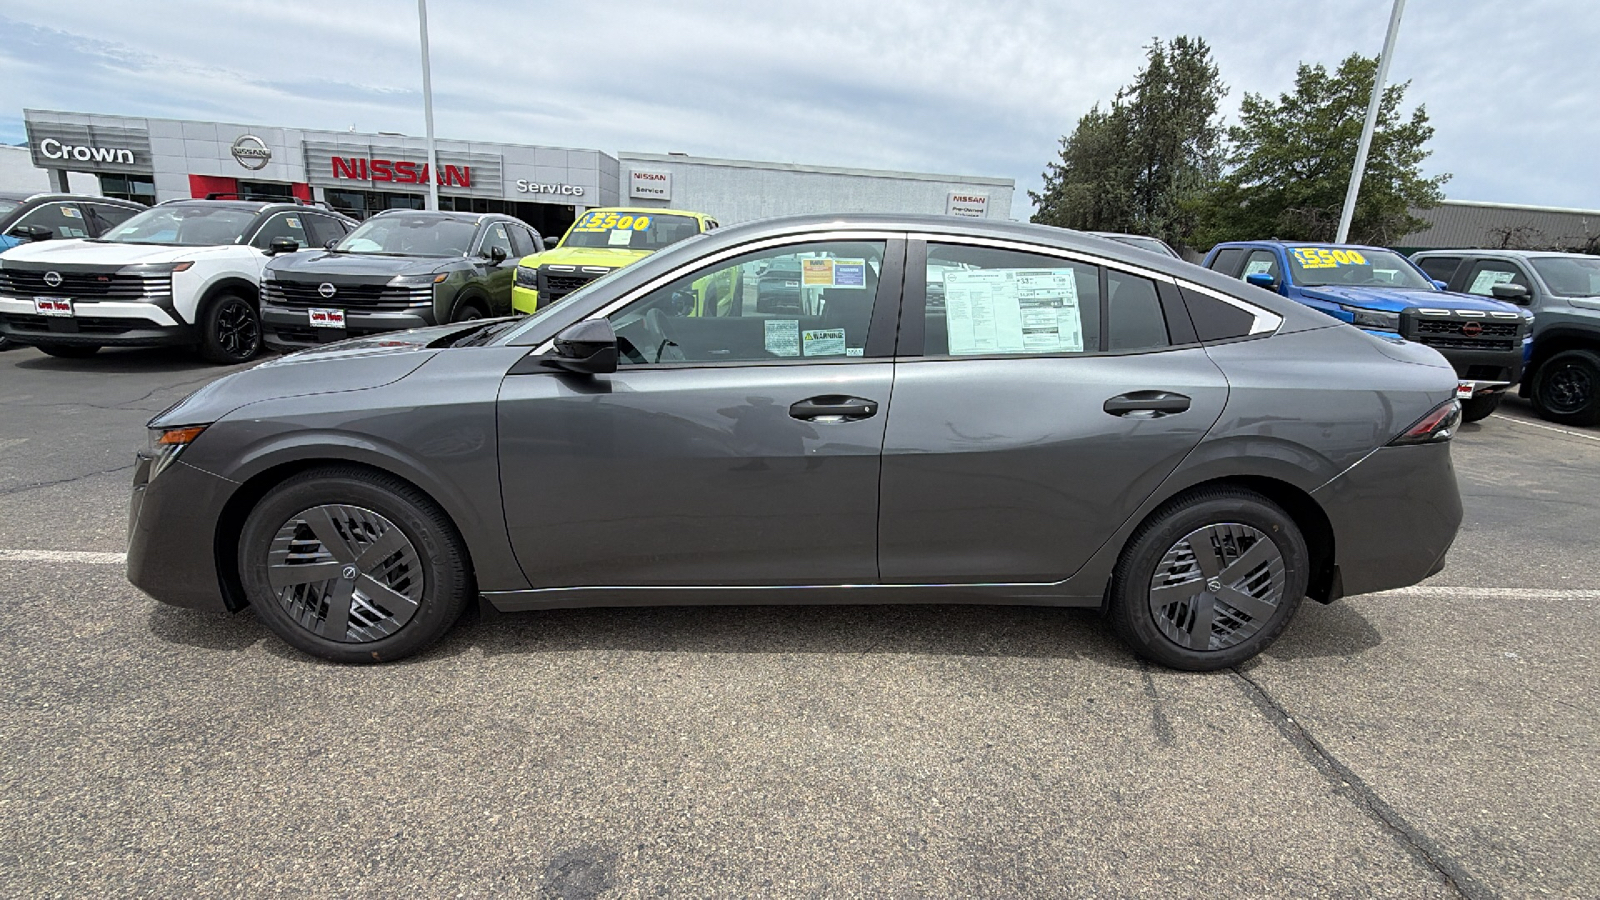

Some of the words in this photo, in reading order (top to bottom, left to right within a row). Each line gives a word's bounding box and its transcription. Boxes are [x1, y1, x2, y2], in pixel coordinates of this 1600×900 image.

[40, 138, 135, 164] Crown
[331, 156, 470, 188] NISSAN
[633, 172, 666, 181] NISSAN
[516, 179, 584, 196] Service
[635, 186, 664, 194] Service
[953, 195, 986, 204] NISSAN
[952, 206, 984, 214] Pre-Owned
[812, 332, 844, 340] WARNING
